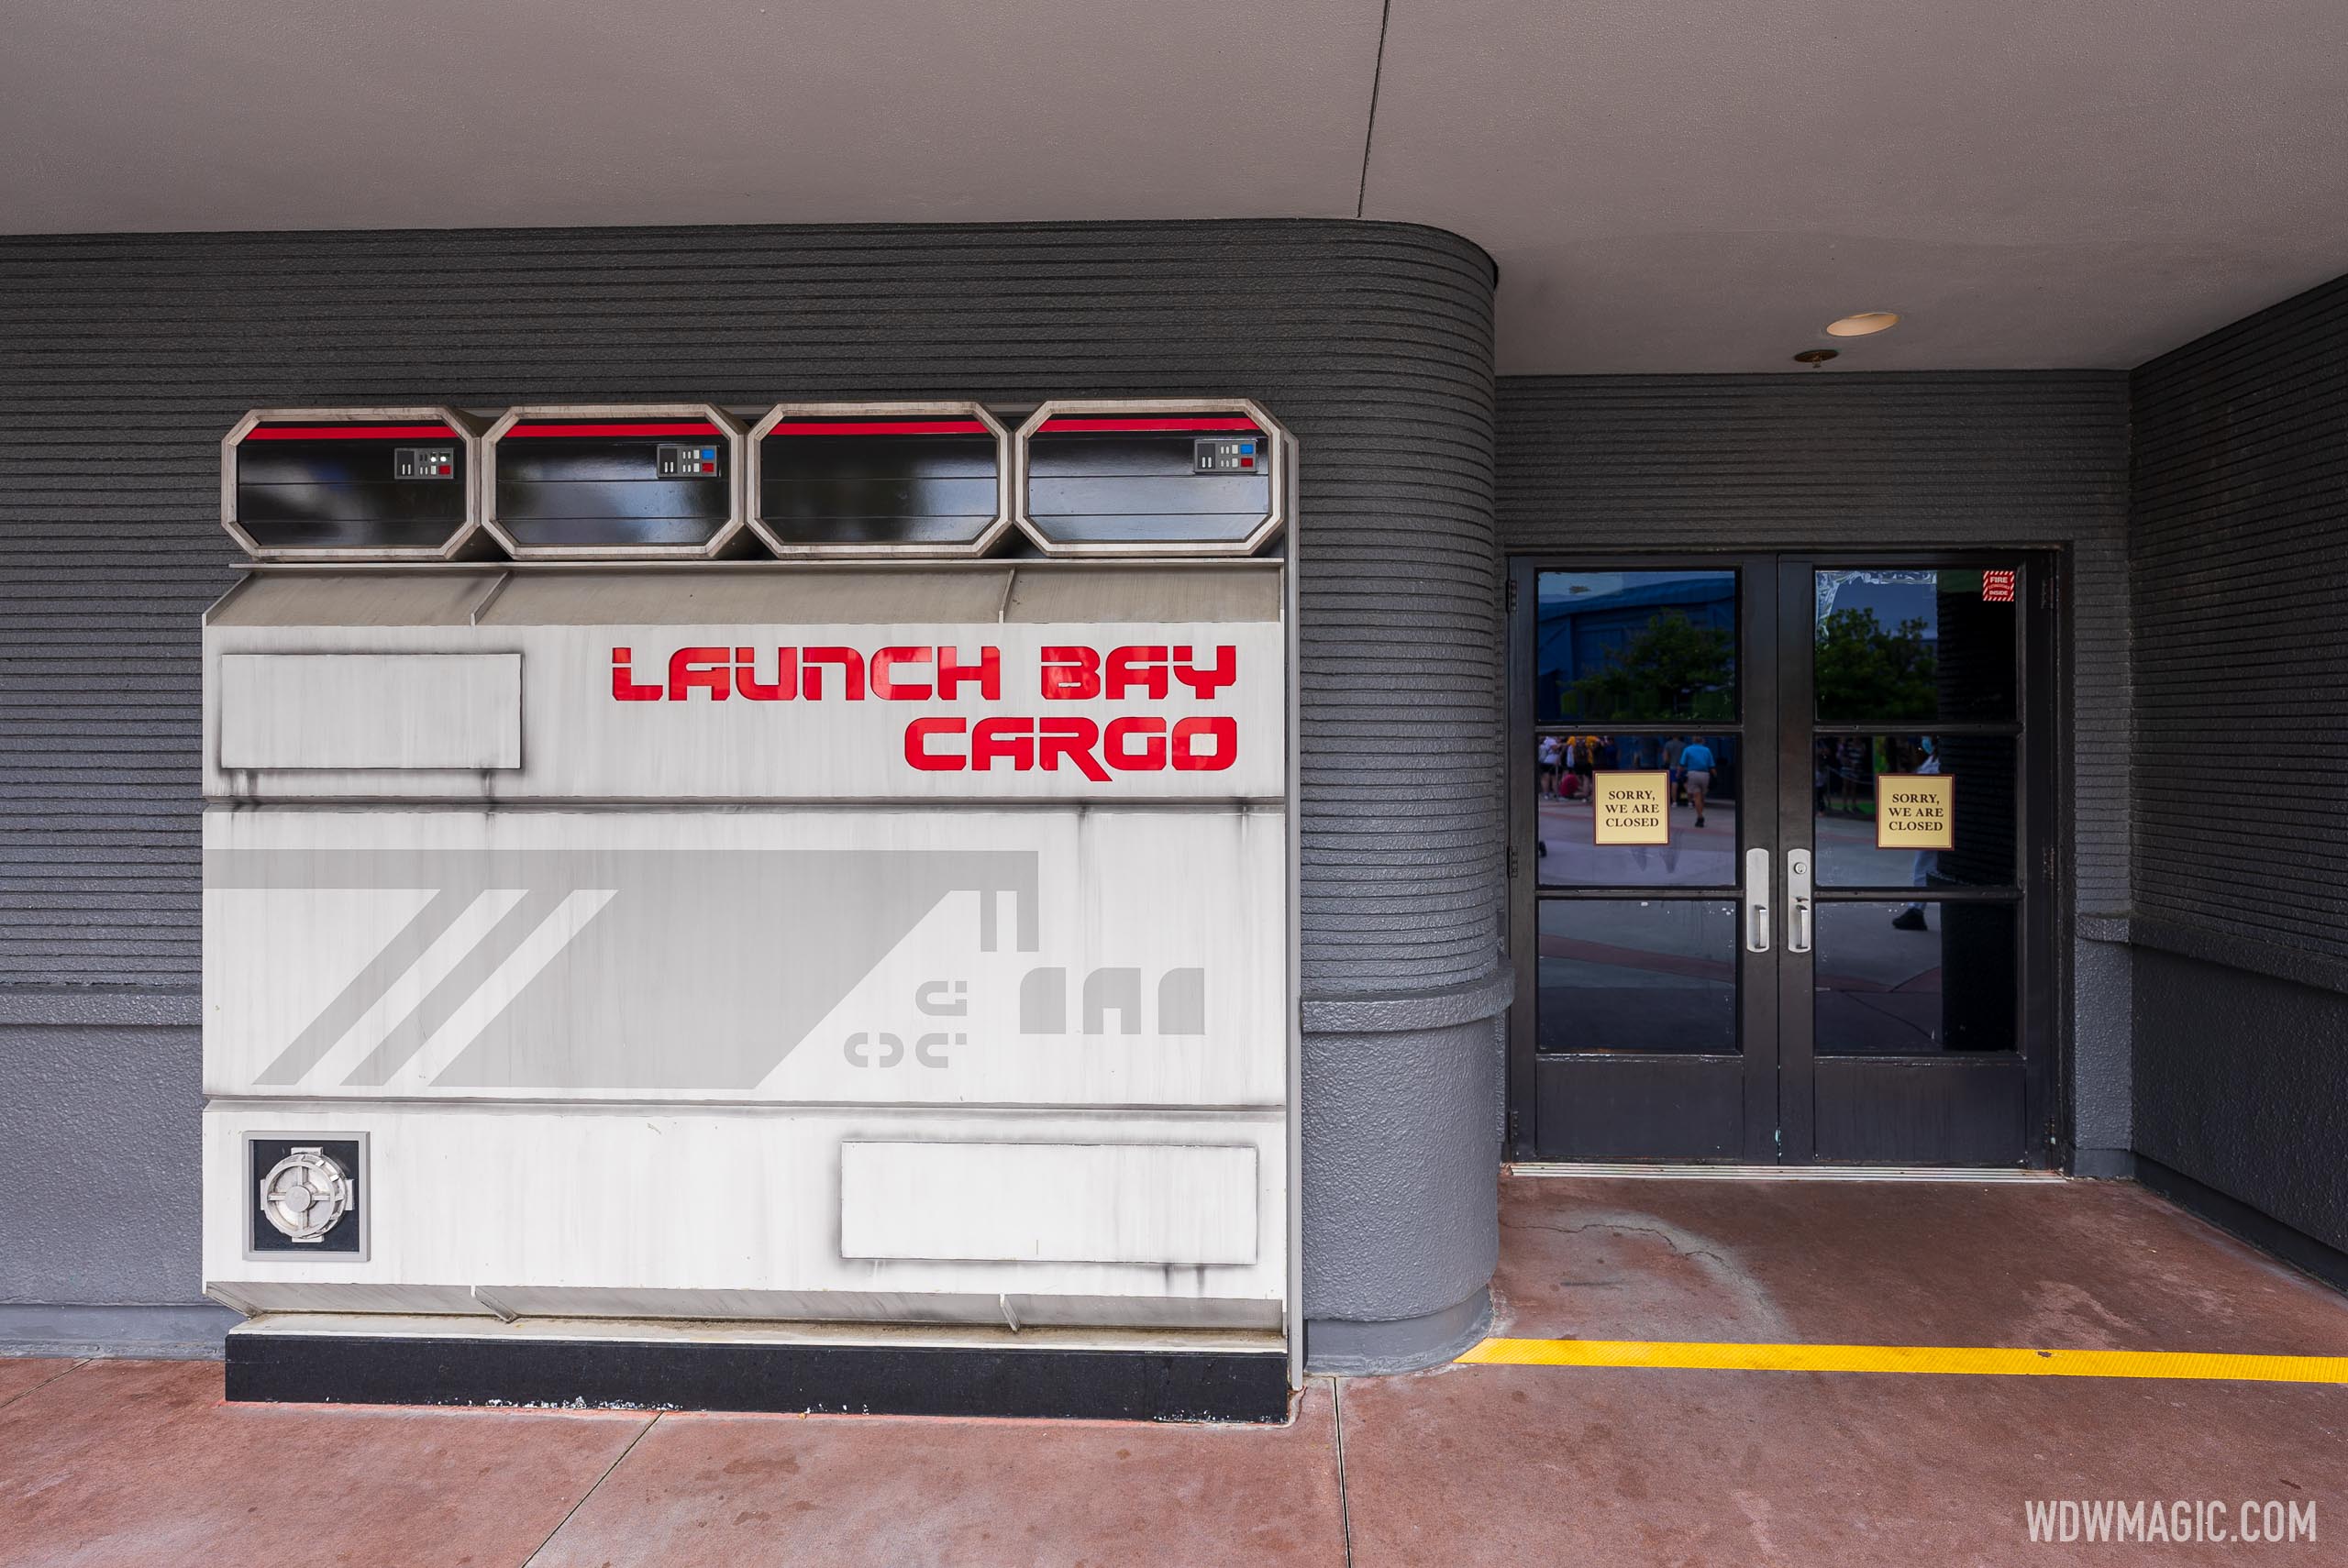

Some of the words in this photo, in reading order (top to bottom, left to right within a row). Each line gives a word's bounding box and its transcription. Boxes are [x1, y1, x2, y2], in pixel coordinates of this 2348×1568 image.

[612, 646, 1001, 701] LAUNCH
[1041, 645, 1237, 701] BAY
[904, 716, 1238, 782] CARGO
[1608, 790, 1656, 801] SORRY,
[1891, 792, 1940, 805] SORRY,
[1605, 803, 1629, 814] WE
[1632, 803, 1660, 814] ARE
[1888, 807, 1912, 817] WE
[1915, 806, 1944, 817] ARE
[1605, 816, 1659, 828] CLOSED
[1888, 821, 1944, 832] CLOSED
